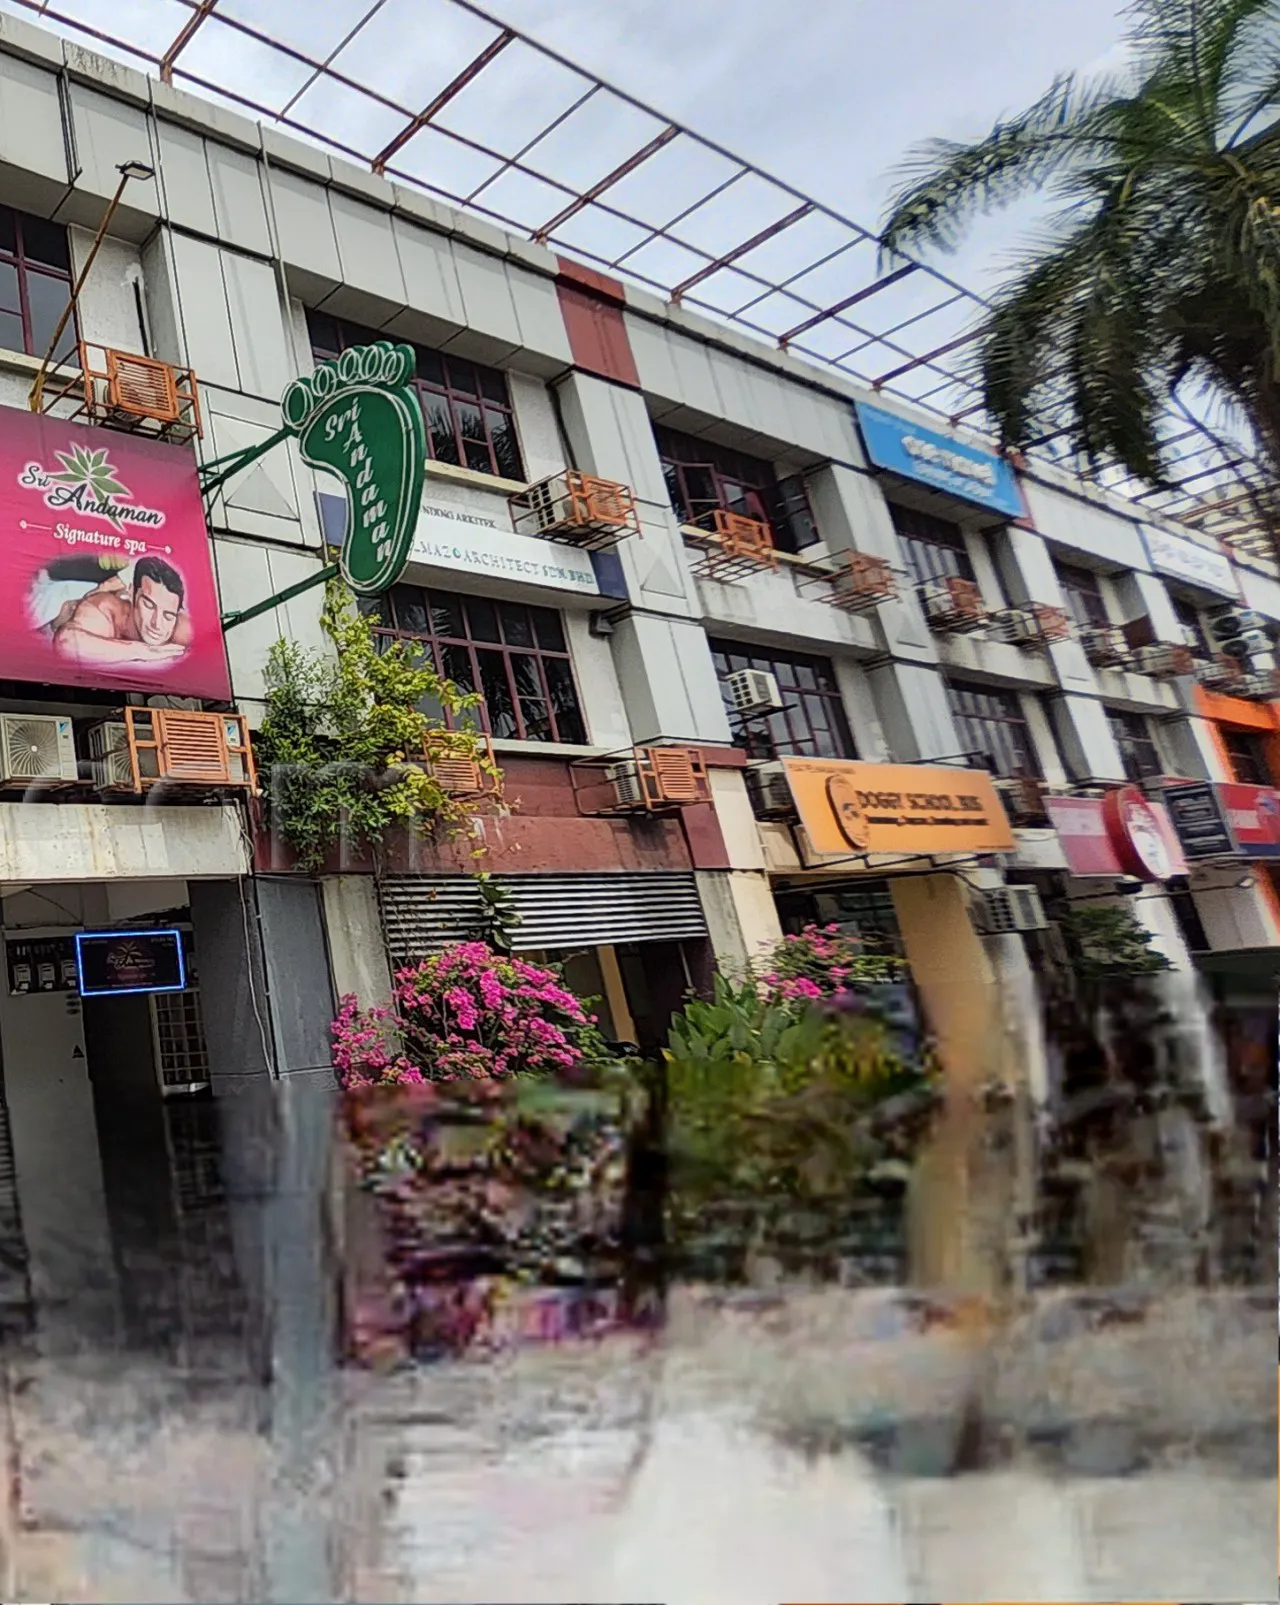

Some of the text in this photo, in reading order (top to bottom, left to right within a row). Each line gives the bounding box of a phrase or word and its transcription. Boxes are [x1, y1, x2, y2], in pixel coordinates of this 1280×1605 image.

[324, 397, 362, 441] Sri
[21, 465, 51, 488] Sri
[47, 483, 163, 526] Andaman
[53, 523, 147, 556] Signature spa
[463, 549, 538, 575] ARCHITECT
